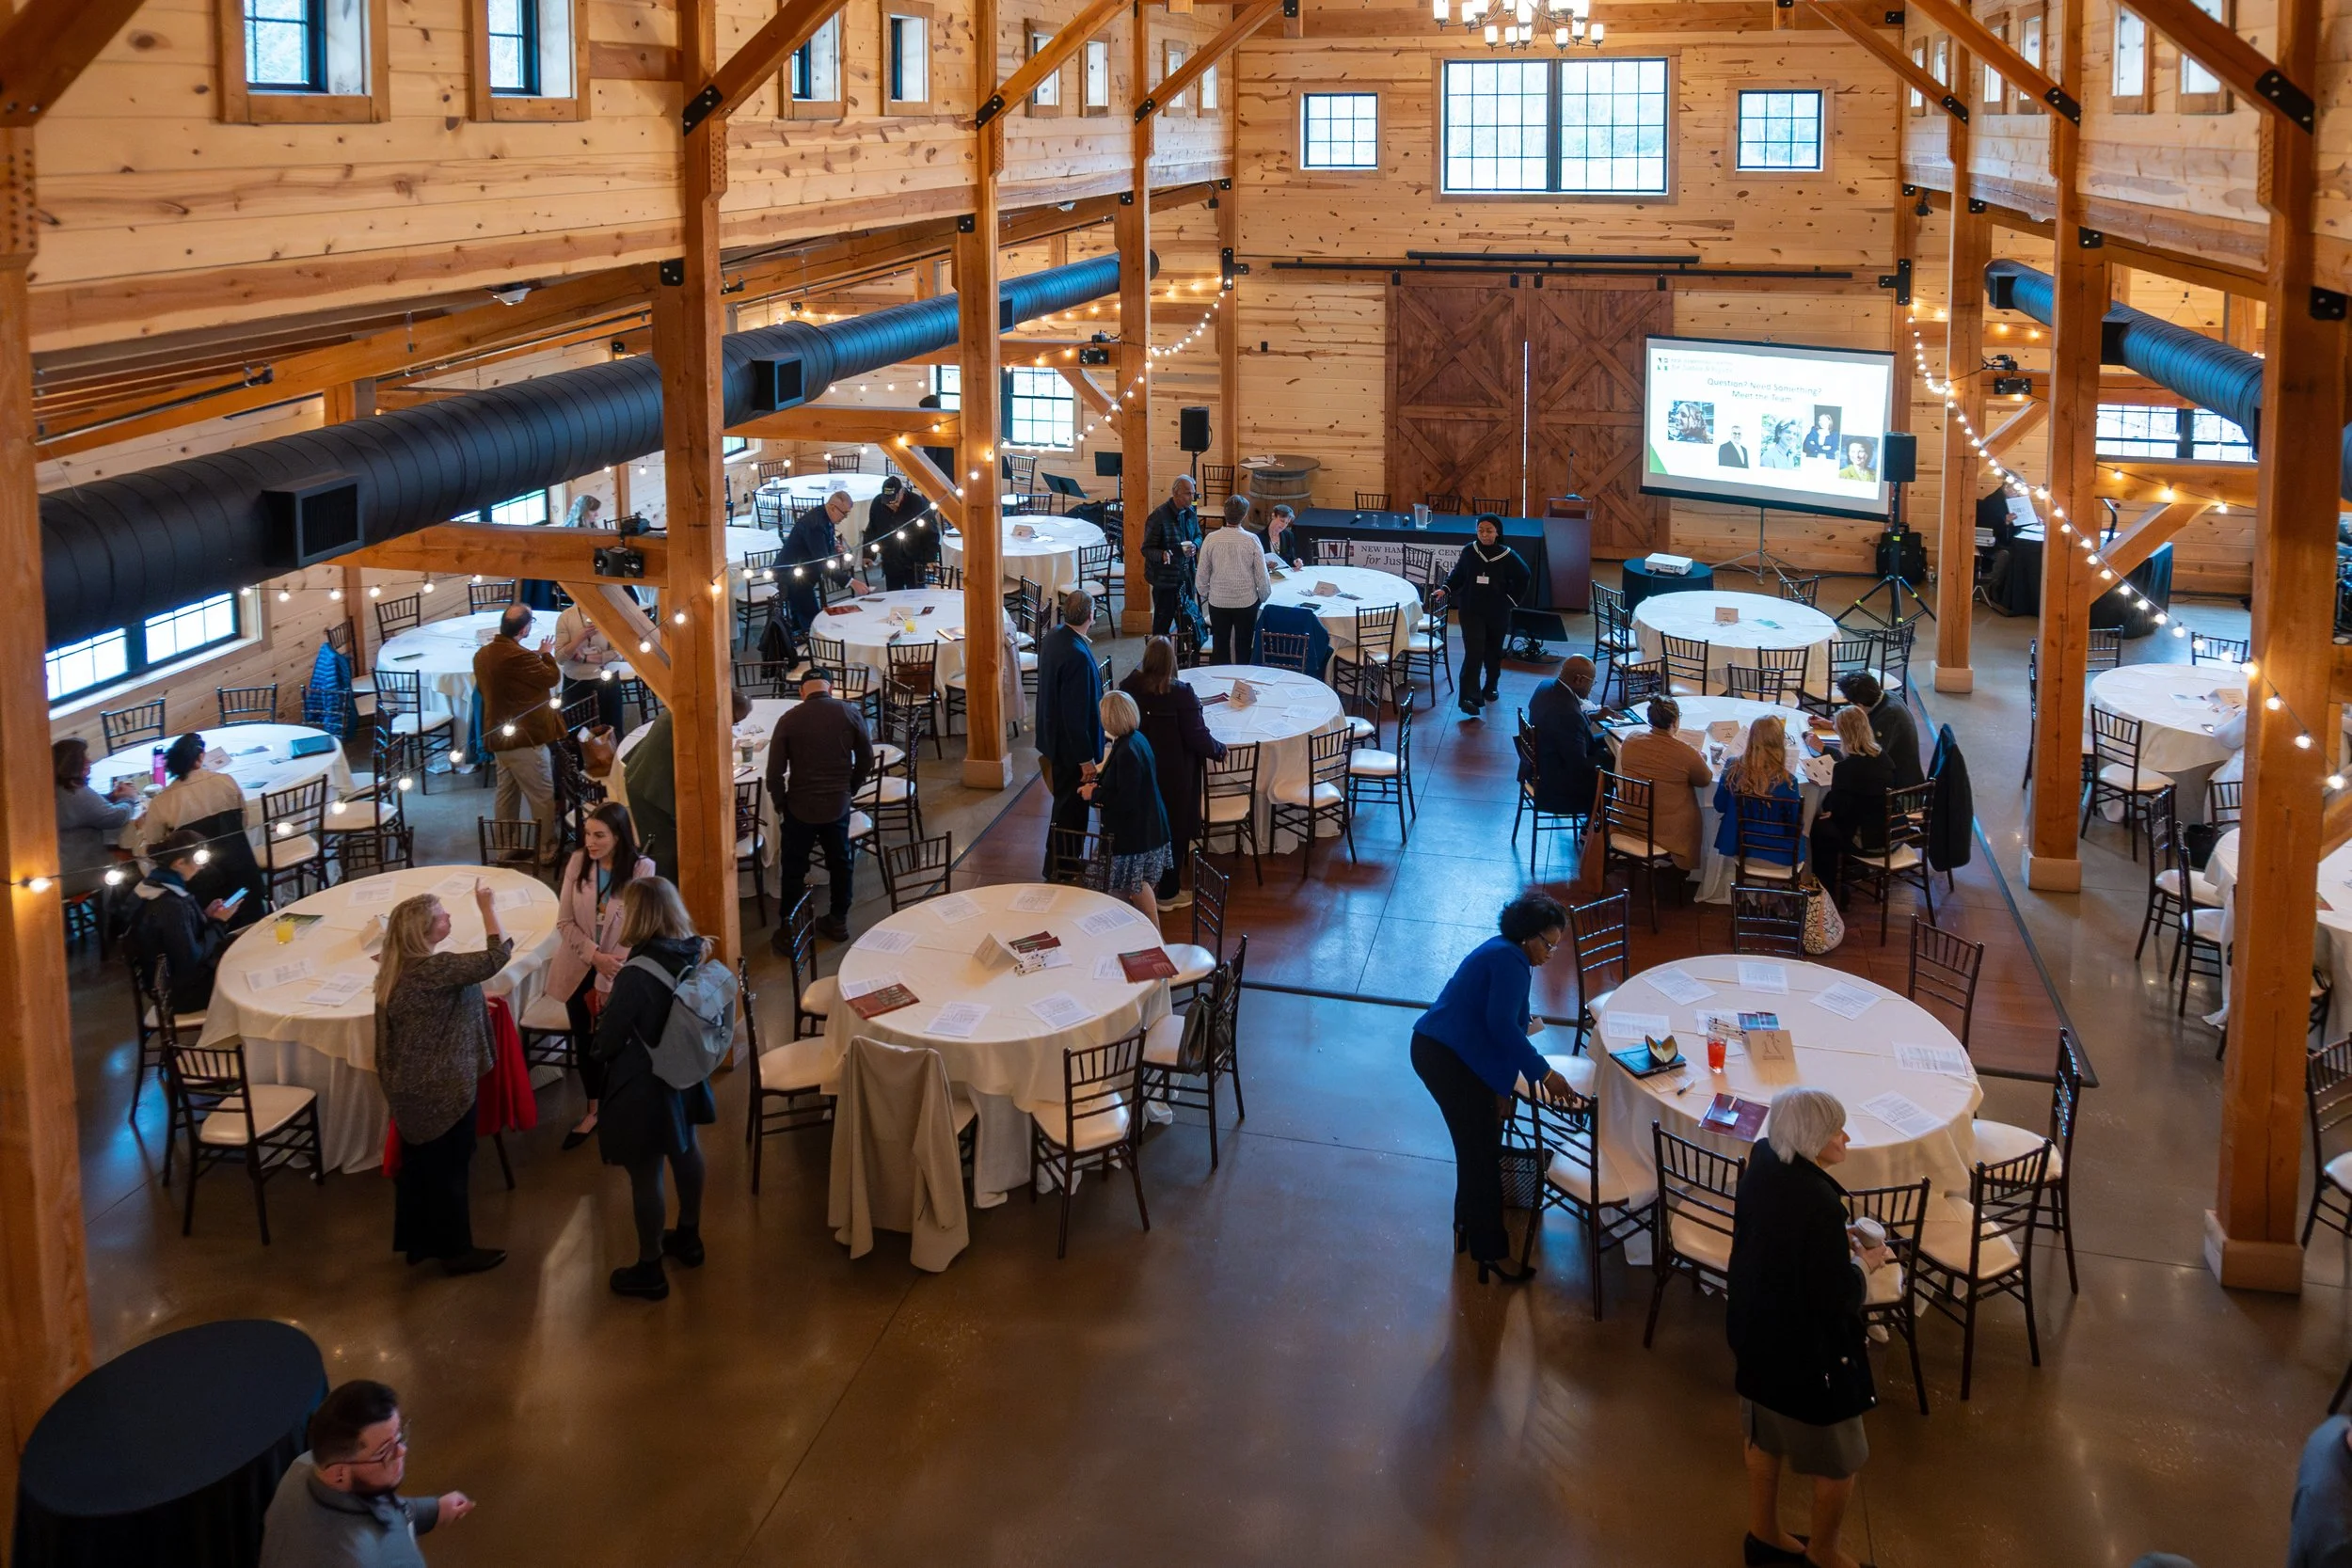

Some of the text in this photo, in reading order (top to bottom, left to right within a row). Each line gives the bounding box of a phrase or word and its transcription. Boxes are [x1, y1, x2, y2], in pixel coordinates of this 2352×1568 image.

[1708, 378, 1822, 397] Question? Need Something?
[1731, 390, 1753, 400] Meet
[1772, 394, 1792, 403] Team
[1363, 553, 1381, 567] for
